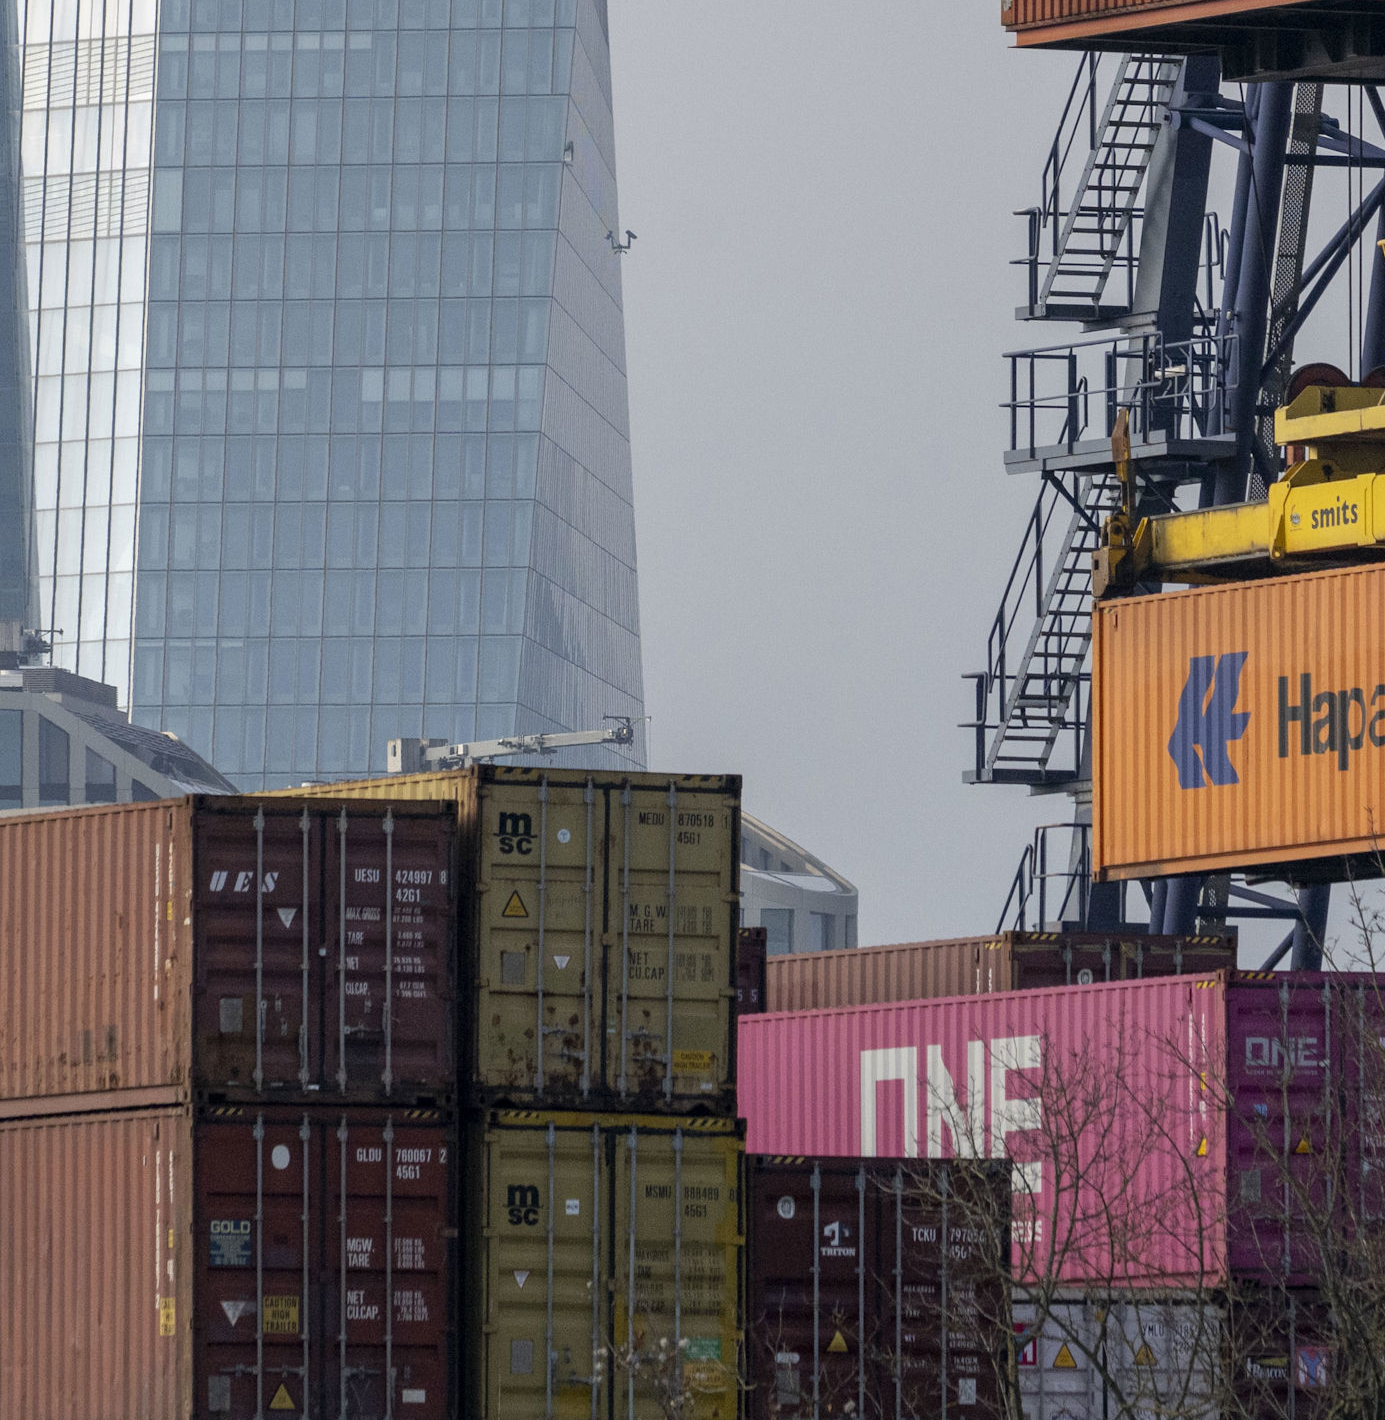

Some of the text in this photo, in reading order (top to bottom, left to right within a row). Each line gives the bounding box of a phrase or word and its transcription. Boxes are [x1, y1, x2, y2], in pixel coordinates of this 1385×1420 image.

[1311, 495, 1358, 529] smits
[639, 812, 665, 825] MEDU
[678, 813, 714, 828] 870518
[677, 831, 701, 845] 45G1
[354, 869, 447, 885] UESU 424997 8
[395, 889, 421, 902] 42G1
[630, 919, 655, 932] TARE
[629, 951, 649, 965] NET
[1245, 1037, 1318, 1067] ONE
[356, 1147, 447, 1163] GLDU 760067 2
[395, 1164, 421, 1179] 45G1
[645, 1185, 672, 1199] MSMU
[684, 1204, 708, 1218] 45G1
[210, 1220, 251, 1234] GOLD
[912, 1227, 936, 1242] TCKU
[820, 1247, 856, 1257] TRITON
[348, 1253, 370, 1268] TARE
[264, 1298, 297, 1309] CAUTION
[347, 1291, 365, 1305] NET
[271, 1310, 290, 1320] HIGH
[265, 1321, 297, 1332] TRAILER
